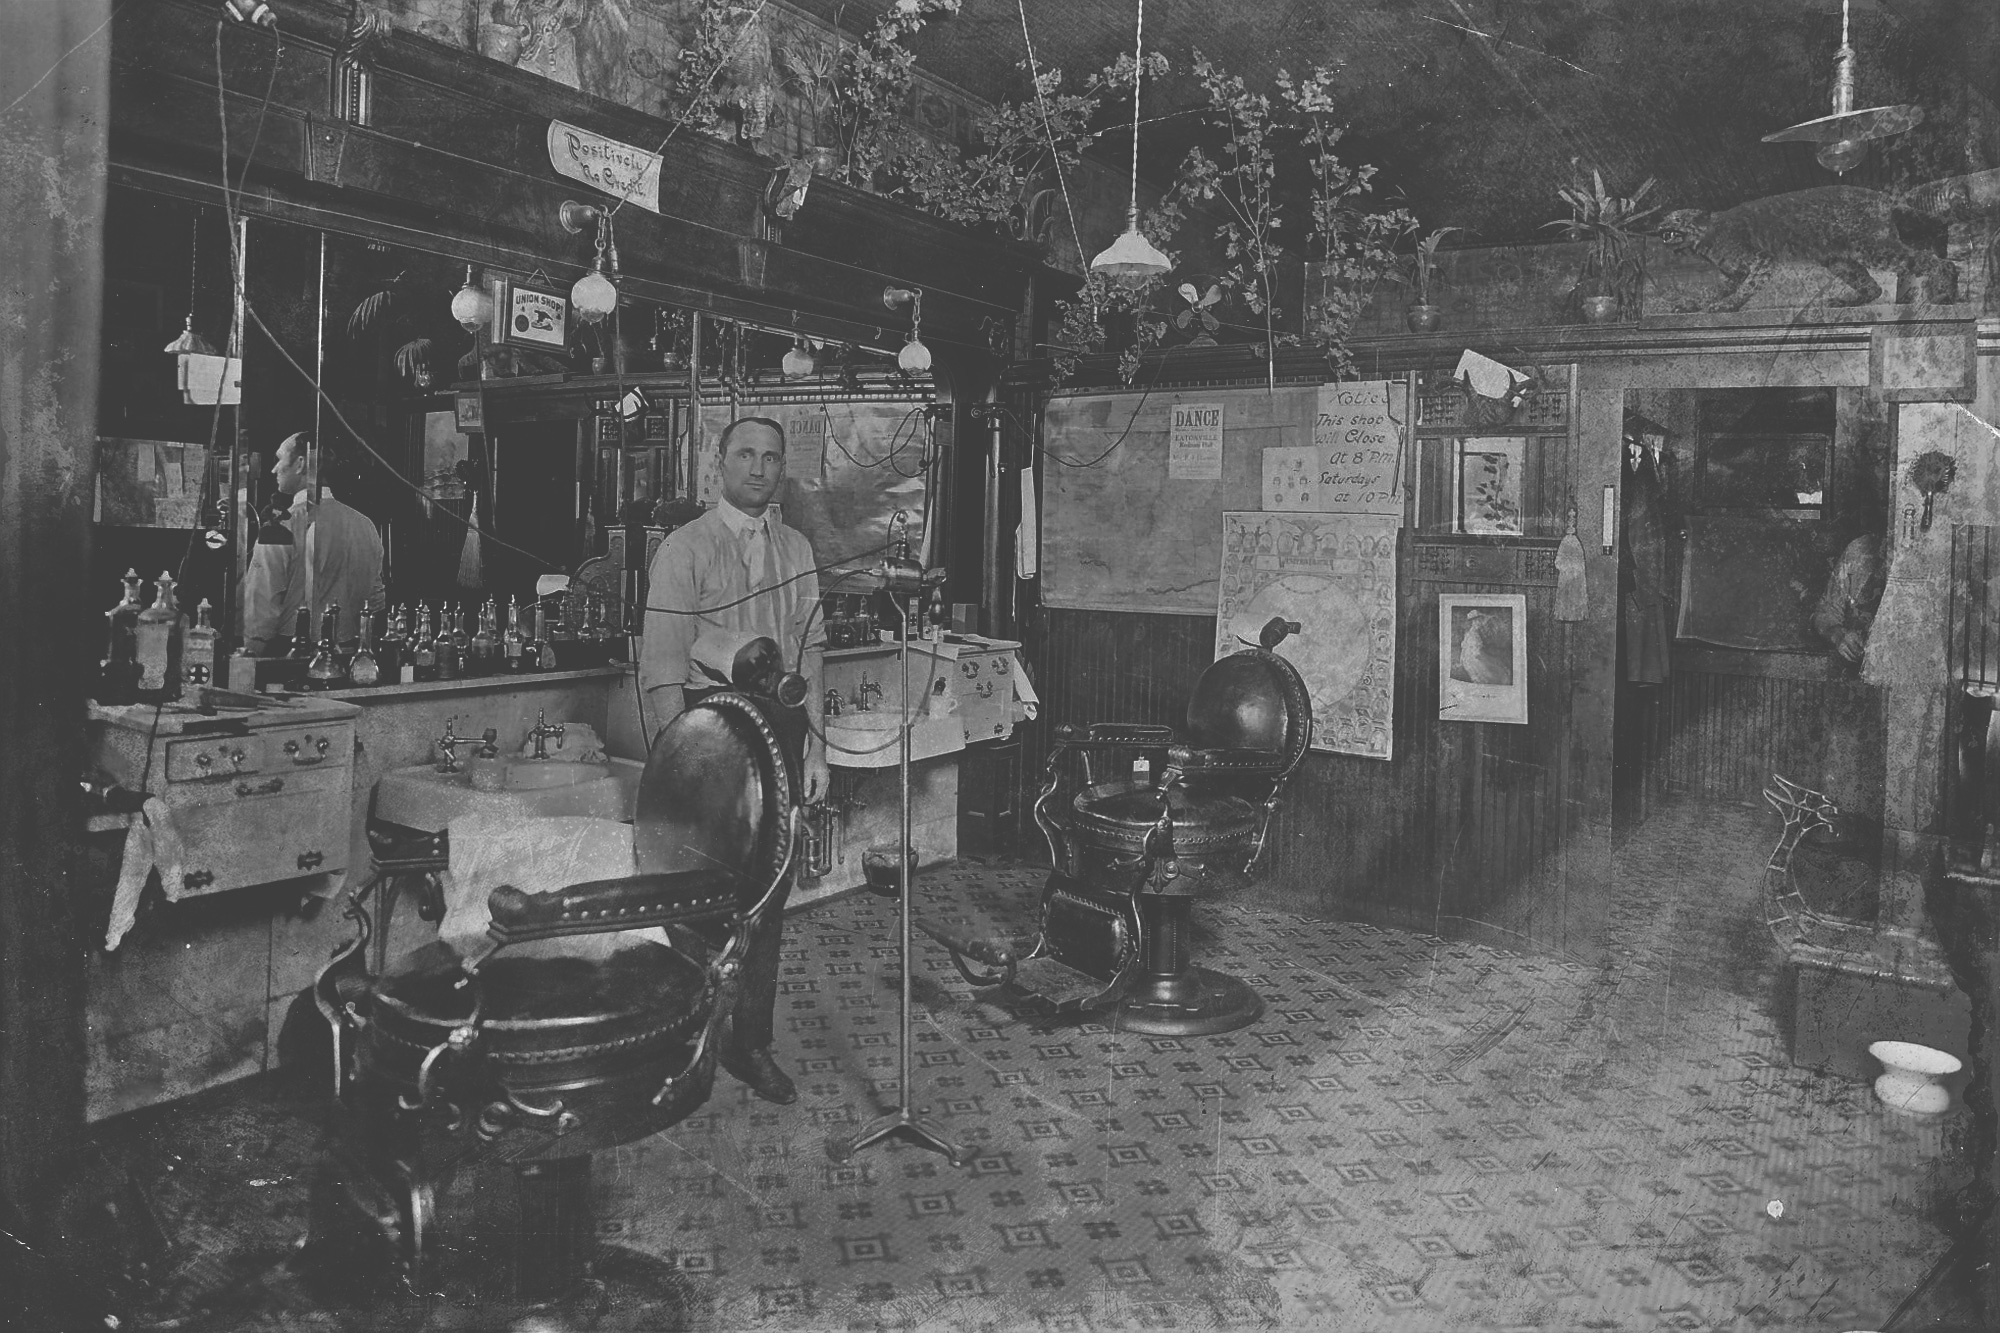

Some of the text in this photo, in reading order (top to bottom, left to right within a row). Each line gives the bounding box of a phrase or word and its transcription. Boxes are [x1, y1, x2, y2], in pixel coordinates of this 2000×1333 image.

[515, 294, 539, 305] UNION
[1175, 409, 1220, 427] DANCE
[1316, 413, 1384, 427] This shop
[1319, 471, 1381, 489] Saturdays
[1357, 492, 1375, 504] 10
